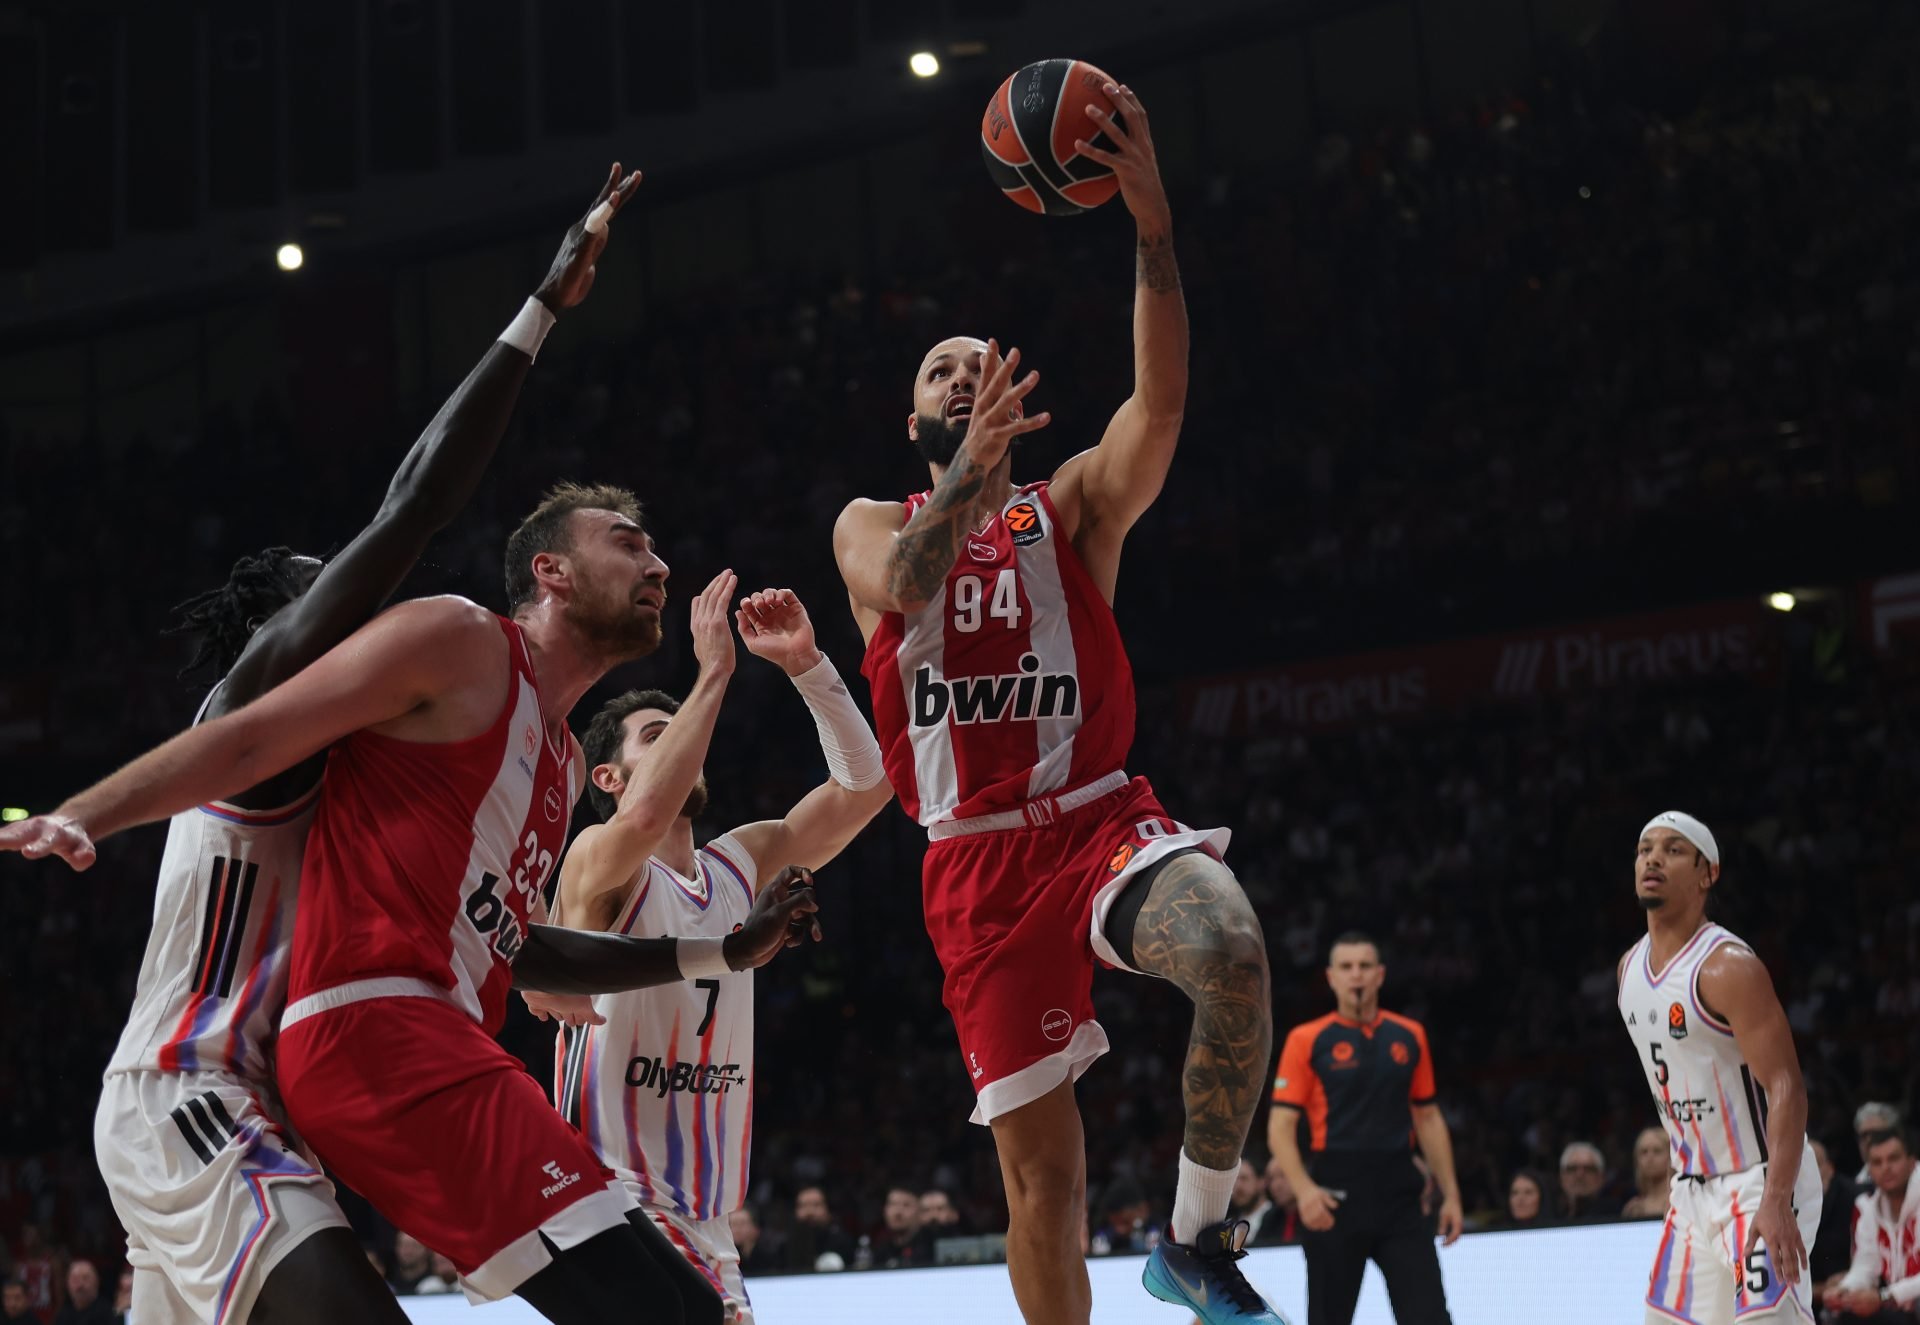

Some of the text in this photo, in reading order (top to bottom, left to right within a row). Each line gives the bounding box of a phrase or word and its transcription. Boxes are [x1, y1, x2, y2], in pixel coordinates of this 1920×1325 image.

[954, 568, 1022, 633] 94
[913, 652, 1081, 728] bwin
[1027, 797, 1054, 827] OLY
[515, 830, 552, 914] 33
[695, 978, 720, 1036] 7
[1650, 1042, 1669, 1086] 5
[541, 1172, 581, 1199] FlexCar
[1744, 1249, 1770, 1294] 5
